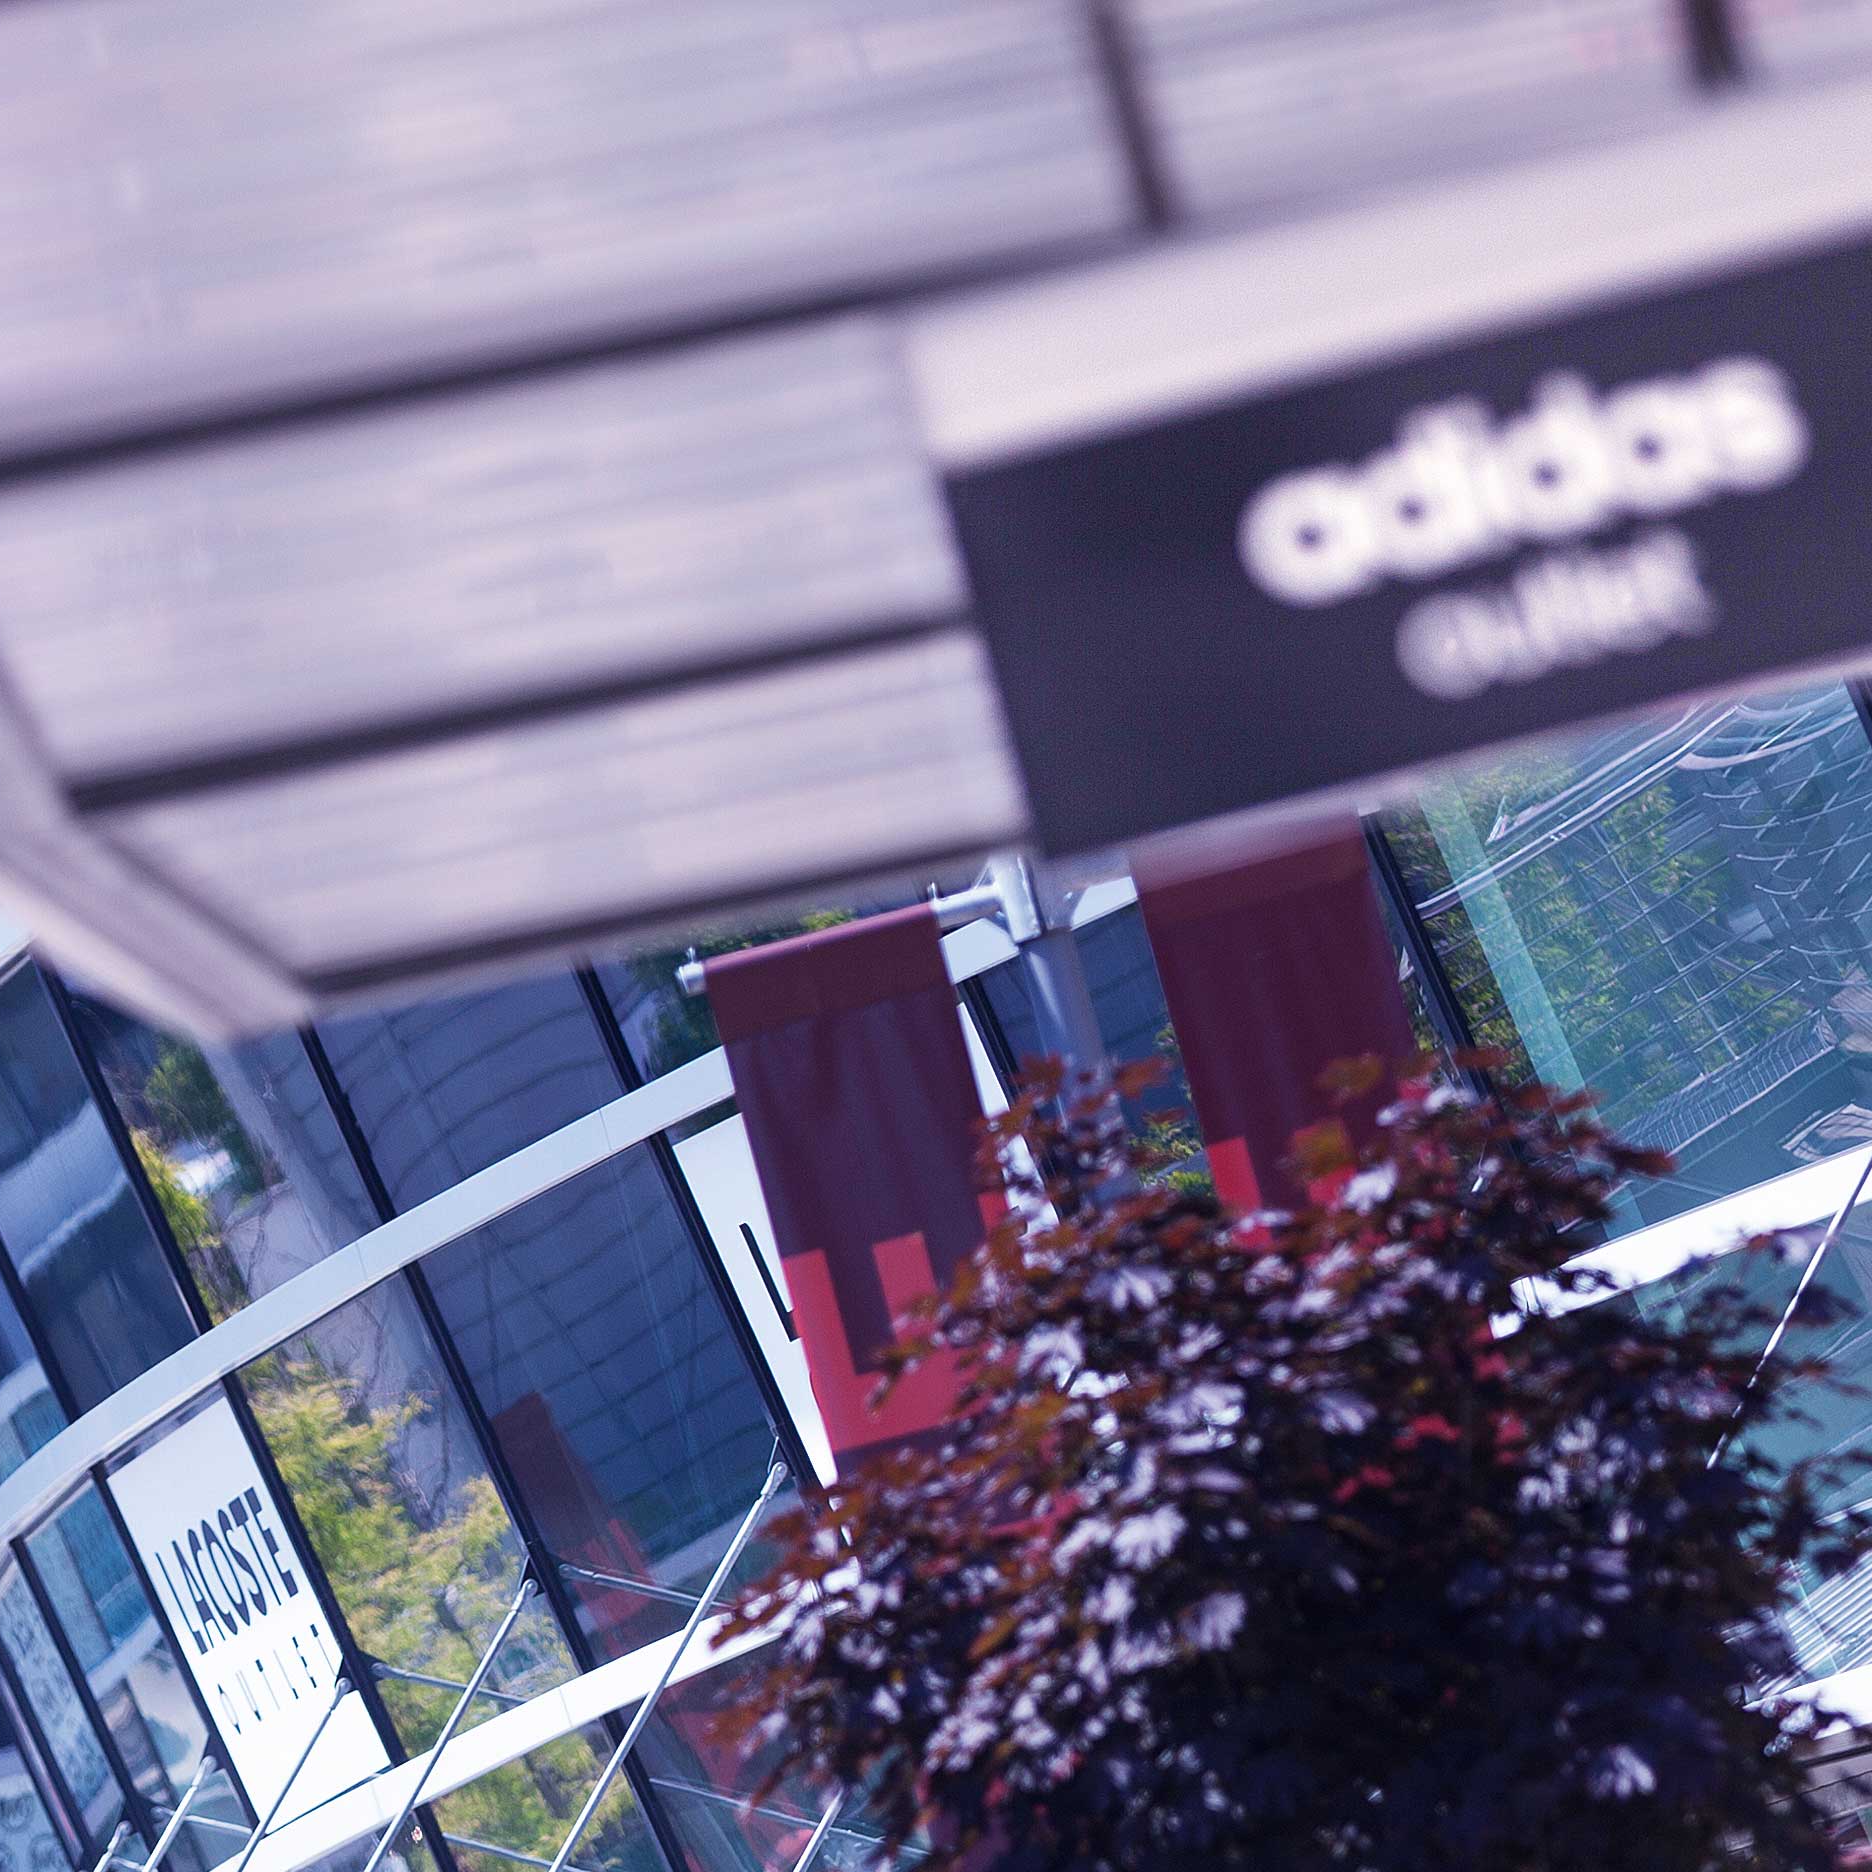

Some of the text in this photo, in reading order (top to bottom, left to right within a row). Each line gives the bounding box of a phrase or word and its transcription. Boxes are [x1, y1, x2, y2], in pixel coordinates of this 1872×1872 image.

[1240, 356, 1808, 607] adidas
[155, 1486, 299, 1655] LACOSTE
[217, 1623, 336, 1735] OUTLET
